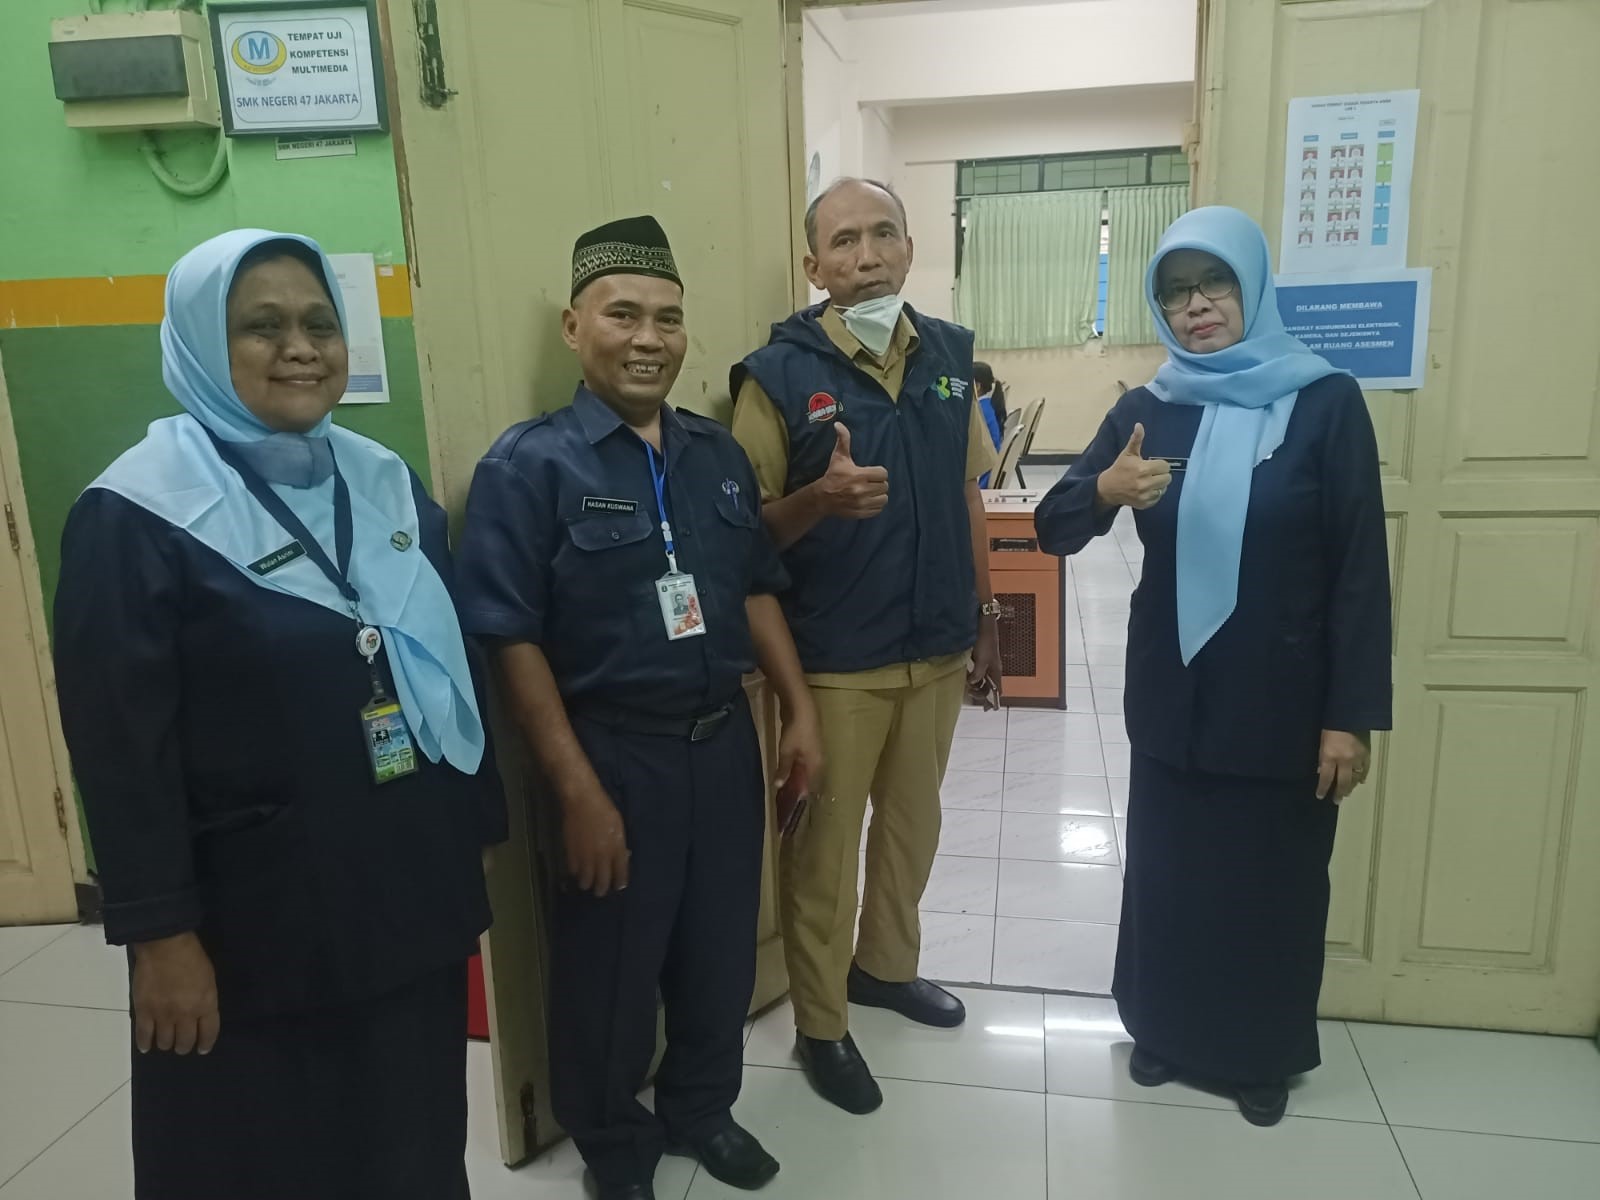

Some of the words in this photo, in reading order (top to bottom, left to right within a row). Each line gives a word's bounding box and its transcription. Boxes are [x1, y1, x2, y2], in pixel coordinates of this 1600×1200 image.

[288, 33, 324, 41] TEMPAT
[327, 32, 342, 40] UJI
[248, 37, 270, 60] M
[290, 49, 349, 59] KOMPETENSI
[292, 65, 348, 74] MULTIMEDIA
[237, 97, 259, 108] SMK
[262, 96, 298, 107] NEGERI
[300, 96, 311, 106] 47
[314, 93, 359, 105] JAKARTA
[325, 138, 352, 146] JAKARTA
[1296, 304, 1338, 312] DILARANG
[1340, 301, 1383, 310] MEMBAWA
[1323, 341, 1352, 349] RUANG
[587, 501, 606, 509] HASAN
[607, 503, 634, 512] KUSWANA
